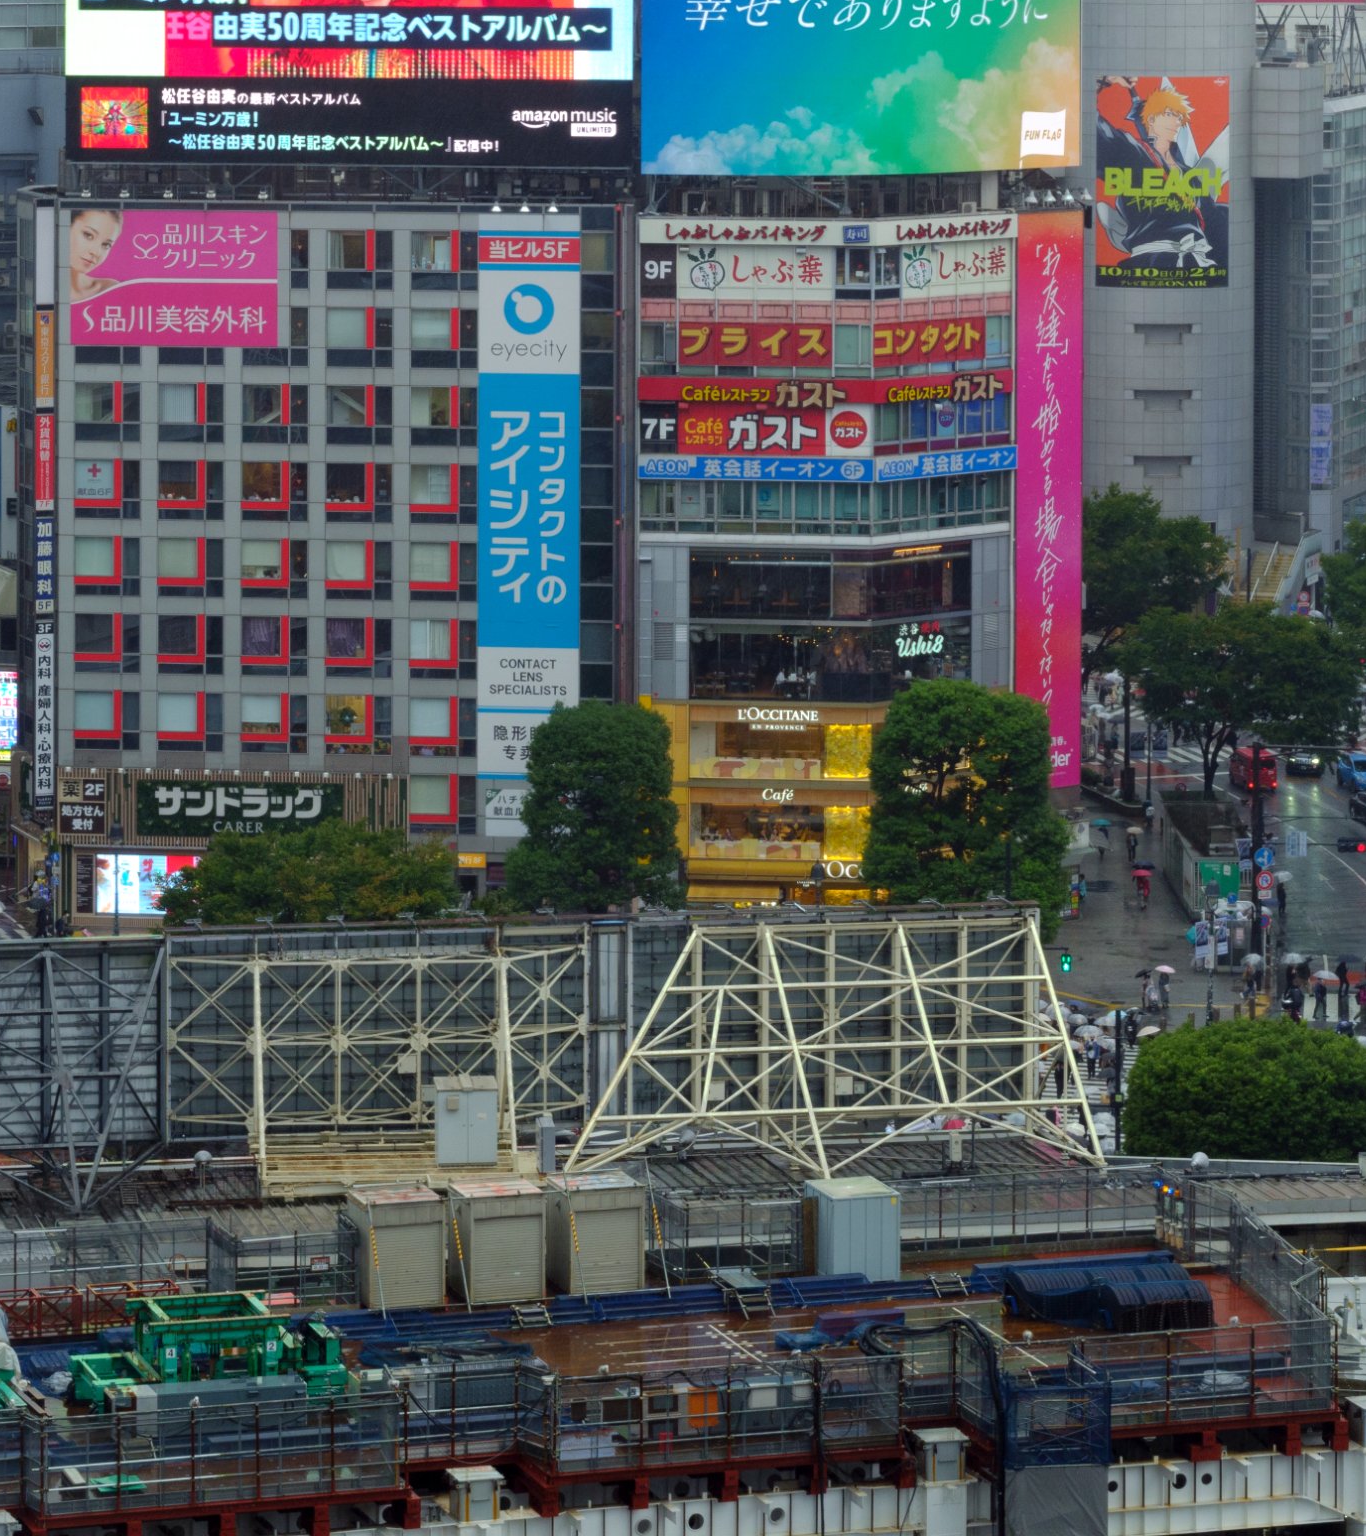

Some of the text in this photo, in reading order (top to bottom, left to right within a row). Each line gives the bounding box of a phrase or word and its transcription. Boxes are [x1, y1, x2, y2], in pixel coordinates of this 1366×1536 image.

[161, 88, 361, 107] 松任谷由実の最新ベストアルバム
[512, 107, 617, 128] amazon music
[576, 125, 614, 135] UNLIMITED
[1024, 127, 1062, 142] FUN FLAG
[1104, 167, 1223, 197] BLEACH
[162, 224, 267, 245] 品川スキン
[665, 222, 827, 242] しゃぶしゃぶバイキング
[896, 218, 1012, 241] しゃぶしゃぶバイキング
[162, 249, 256, 270] クリニック
[488, 240, 570, 262] 当ビル5F
[644, 260, 673, 280] 9F
[732, 255, 823, 285] しゃぶ葉
[939, 245, 1006, 280] しゃぶ葉
[100, 305, 267, 335] 品川美容外科
[681, 326, 828, 357] プライス
[873, 322, 980, 356] コンタクト
[490, 338, 568, 362] eyecity
[682, 378, 847, 409] Caféレストラン ガスト
[953, 373, 1004, 402] ガスト
[642, 418, 676, 440] 7F
[685, 417, 723, 434] Café
[729, 414, 817, 450] ガスト
[835, 427, 864, 438] ガスト
[685, 435, 723, 446] レストラン
[646, 459, 689, 475] AEON
[704, 459, 863, 478] 英会話イーオン 6F
[882, 460, 913, 476] AEON
[922, 448, 1015, 473] 英会話イーオン
[39, 501, 50, 509] 7F
[489, 411, 531, 603] アイシティ
[537, 412, 567, 605] コンタクトの
[37, 522, 53, 596] 加藤眼科
[38, 601, 52, 611] 5F
[37, 623, 52, 634] 3F
[895, 633, 944, 658] Ushi8
[37, 655, 52, 679] 内科
[499, 659, 557, 670] CONTACT
[512, 672, 543, 682] LENS
[489, 685, 567, 696] SPECIALISTS
[738, 707, 819, 722] L'OCCITANE
[63, 781, 80, 797] 薬
[85, 784, 104, 796] 2F
[762, 788, 794, 804] Café
[61, 806, 104, 817] 処方せん
[155, 788, 323, 819] サンドラッグ
[72, 819, 94, 831] 受付
[167, 1349, 174, 1357] 4
[268, 1342, 275, 1351] 2
